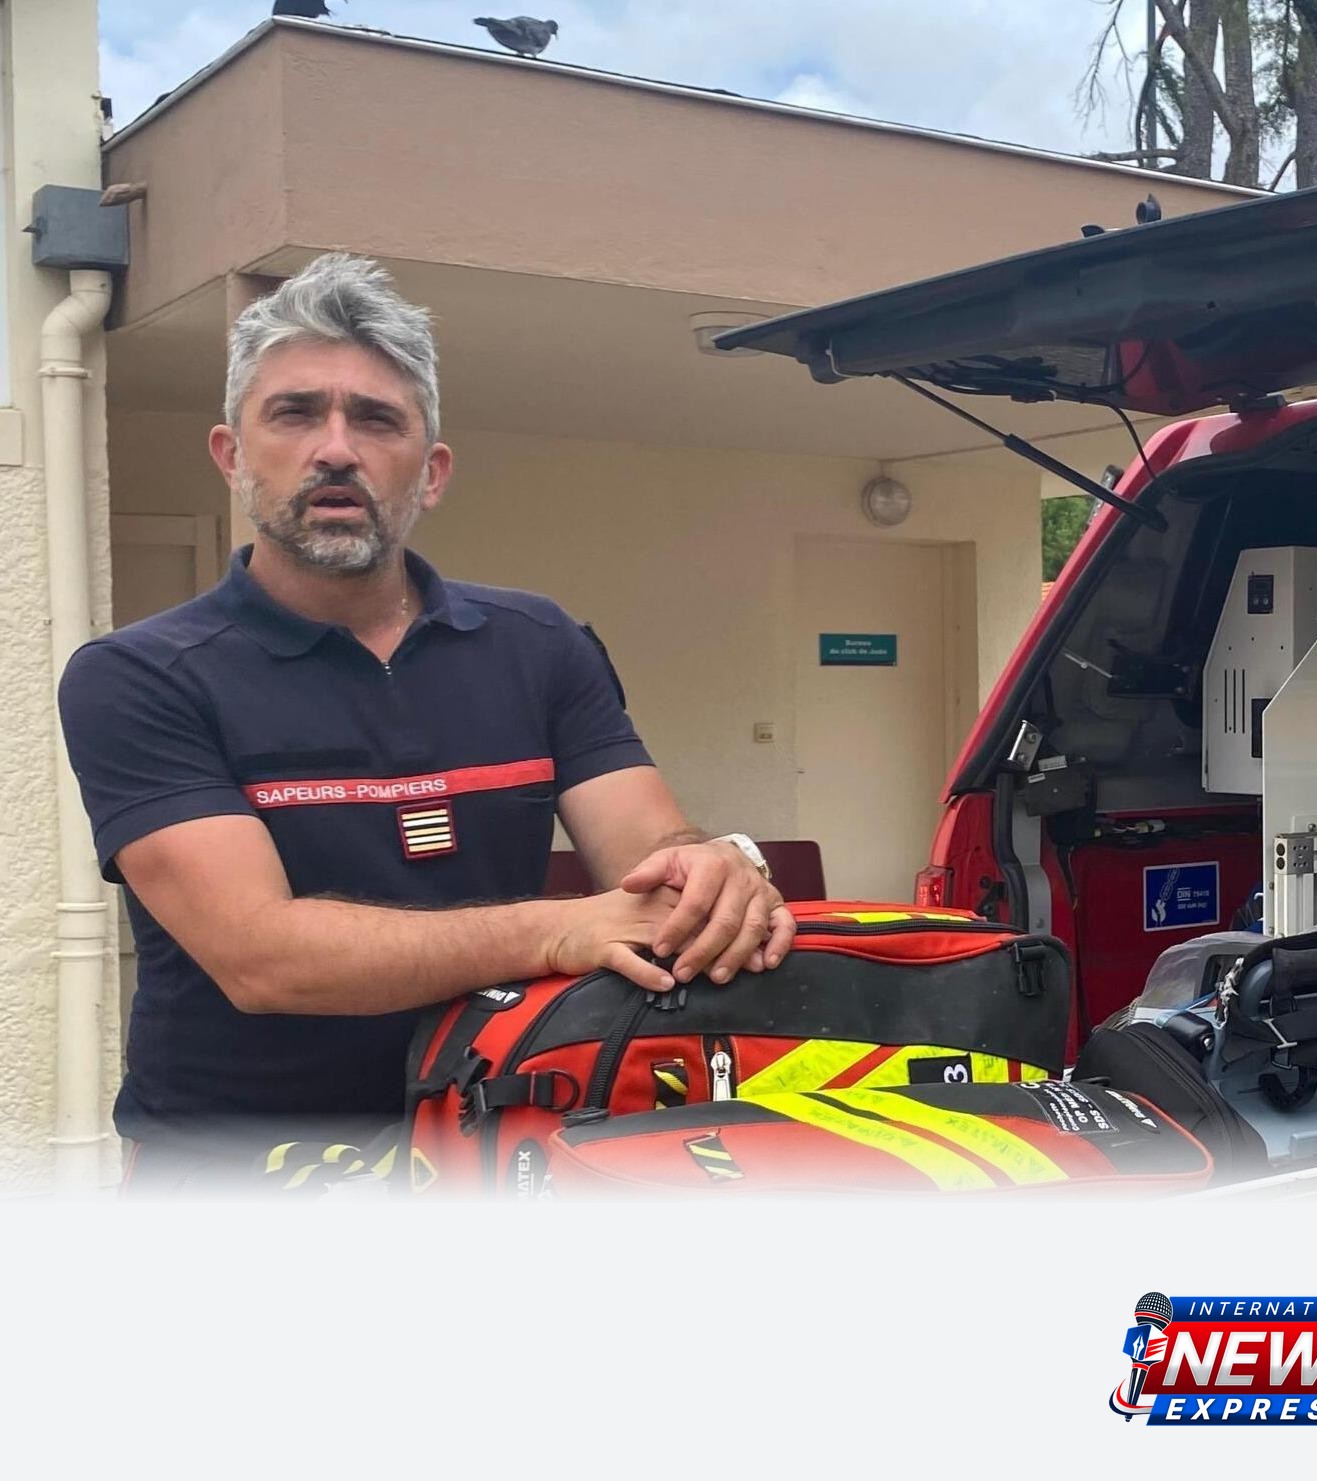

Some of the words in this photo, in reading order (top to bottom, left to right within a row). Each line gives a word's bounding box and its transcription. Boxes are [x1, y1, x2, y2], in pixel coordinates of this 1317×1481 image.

[256, 778, 448, 804] SAPEURS-POMPIERS
[1074, 1110, 1089, 1123] OP
[1089, 1109, 1110, 1130] SDS
